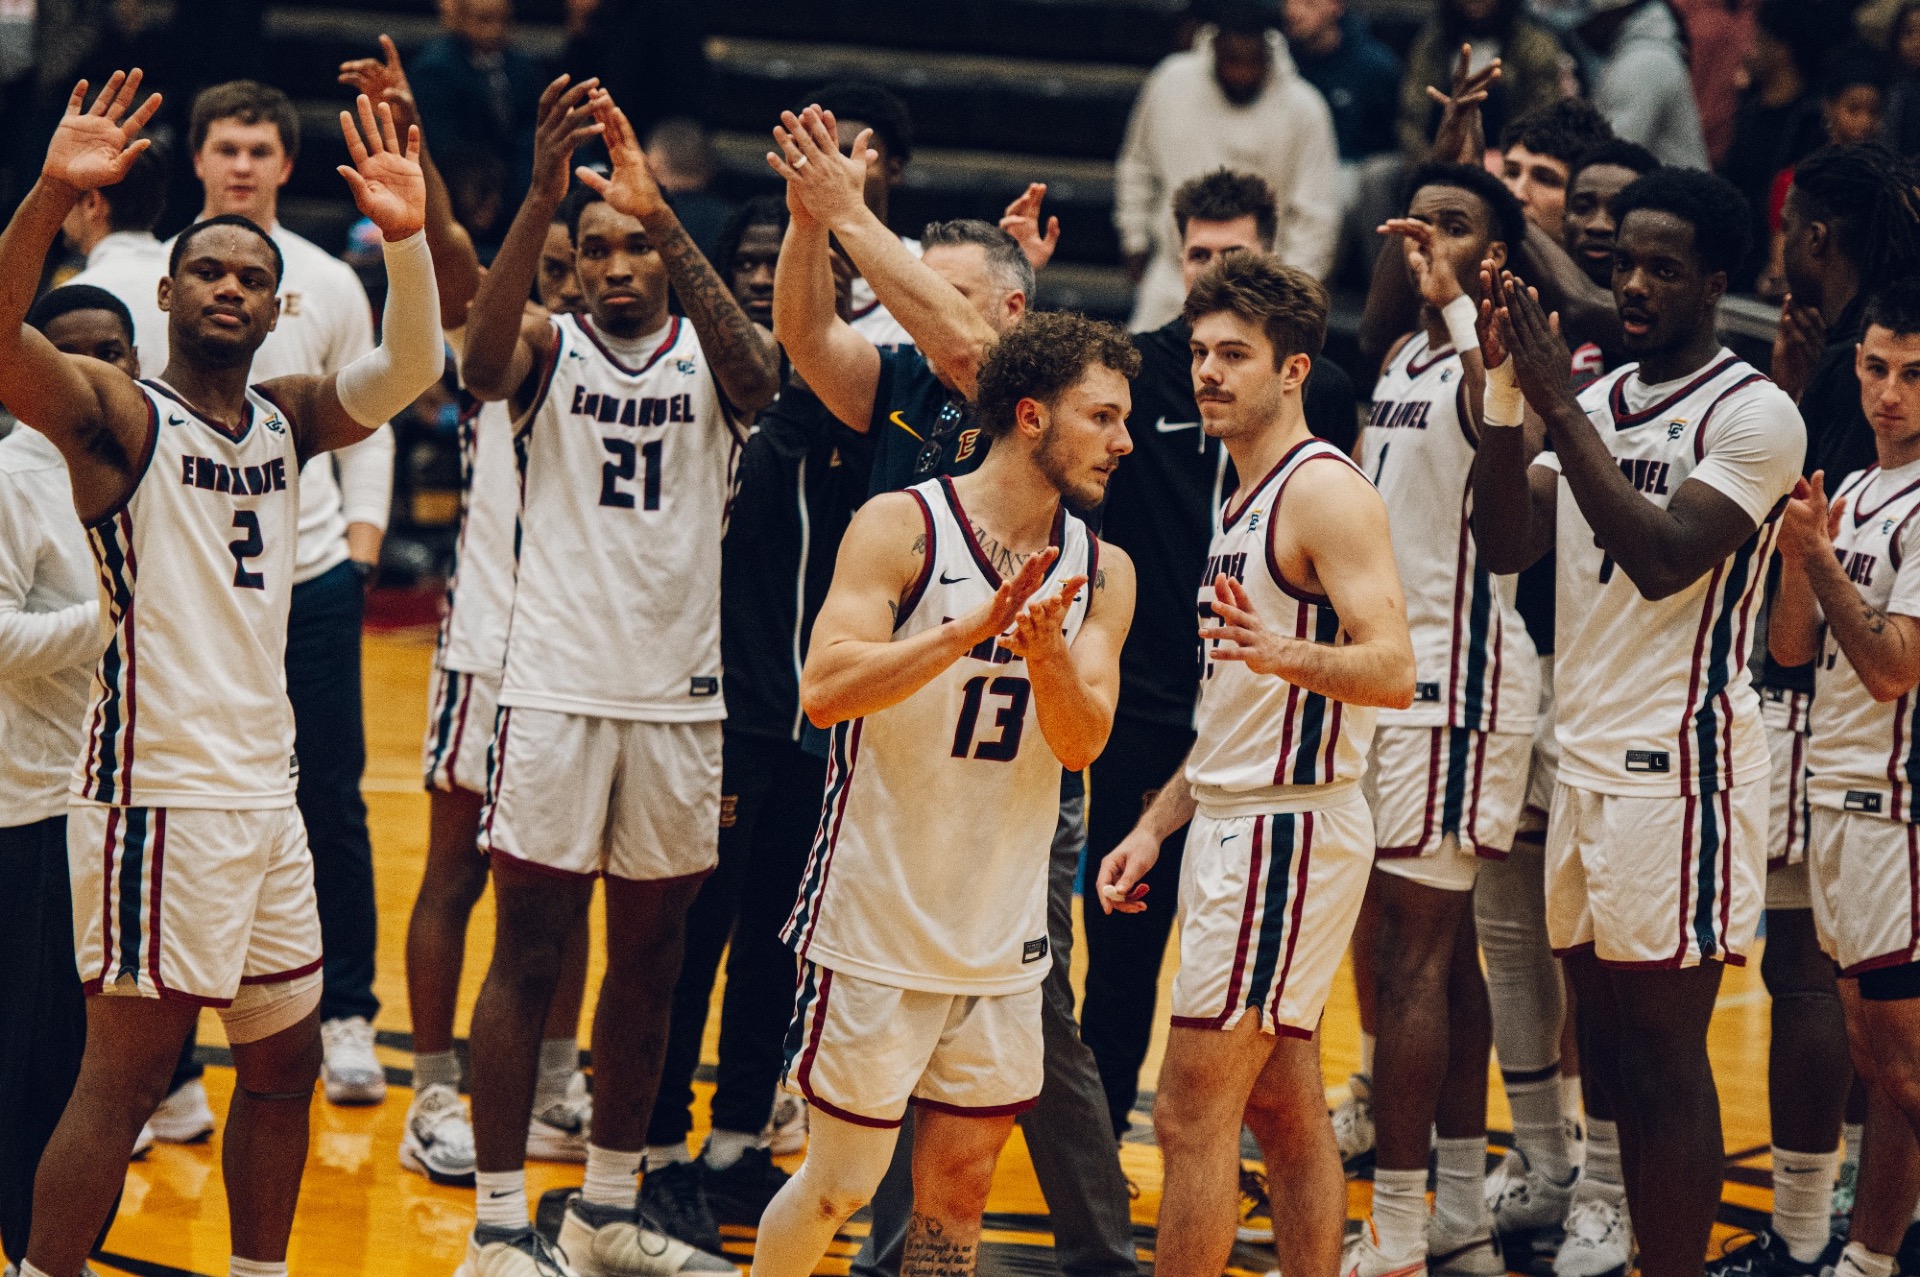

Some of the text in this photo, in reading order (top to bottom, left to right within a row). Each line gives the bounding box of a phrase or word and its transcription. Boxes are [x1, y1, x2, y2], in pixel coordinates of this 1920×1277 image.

[571, 384, 695, 427] EMMANUEL
[955, 428, 981, 463] E
[181, 454, 286, 495] EMMANUE
[598, 437, 663, 511] 21
[228, 509, 265, 591] 2
[950, 675, 1031, 763] 13
[1655, 756, 1663, 767] L
[1868, 798, 1877, 807] M
